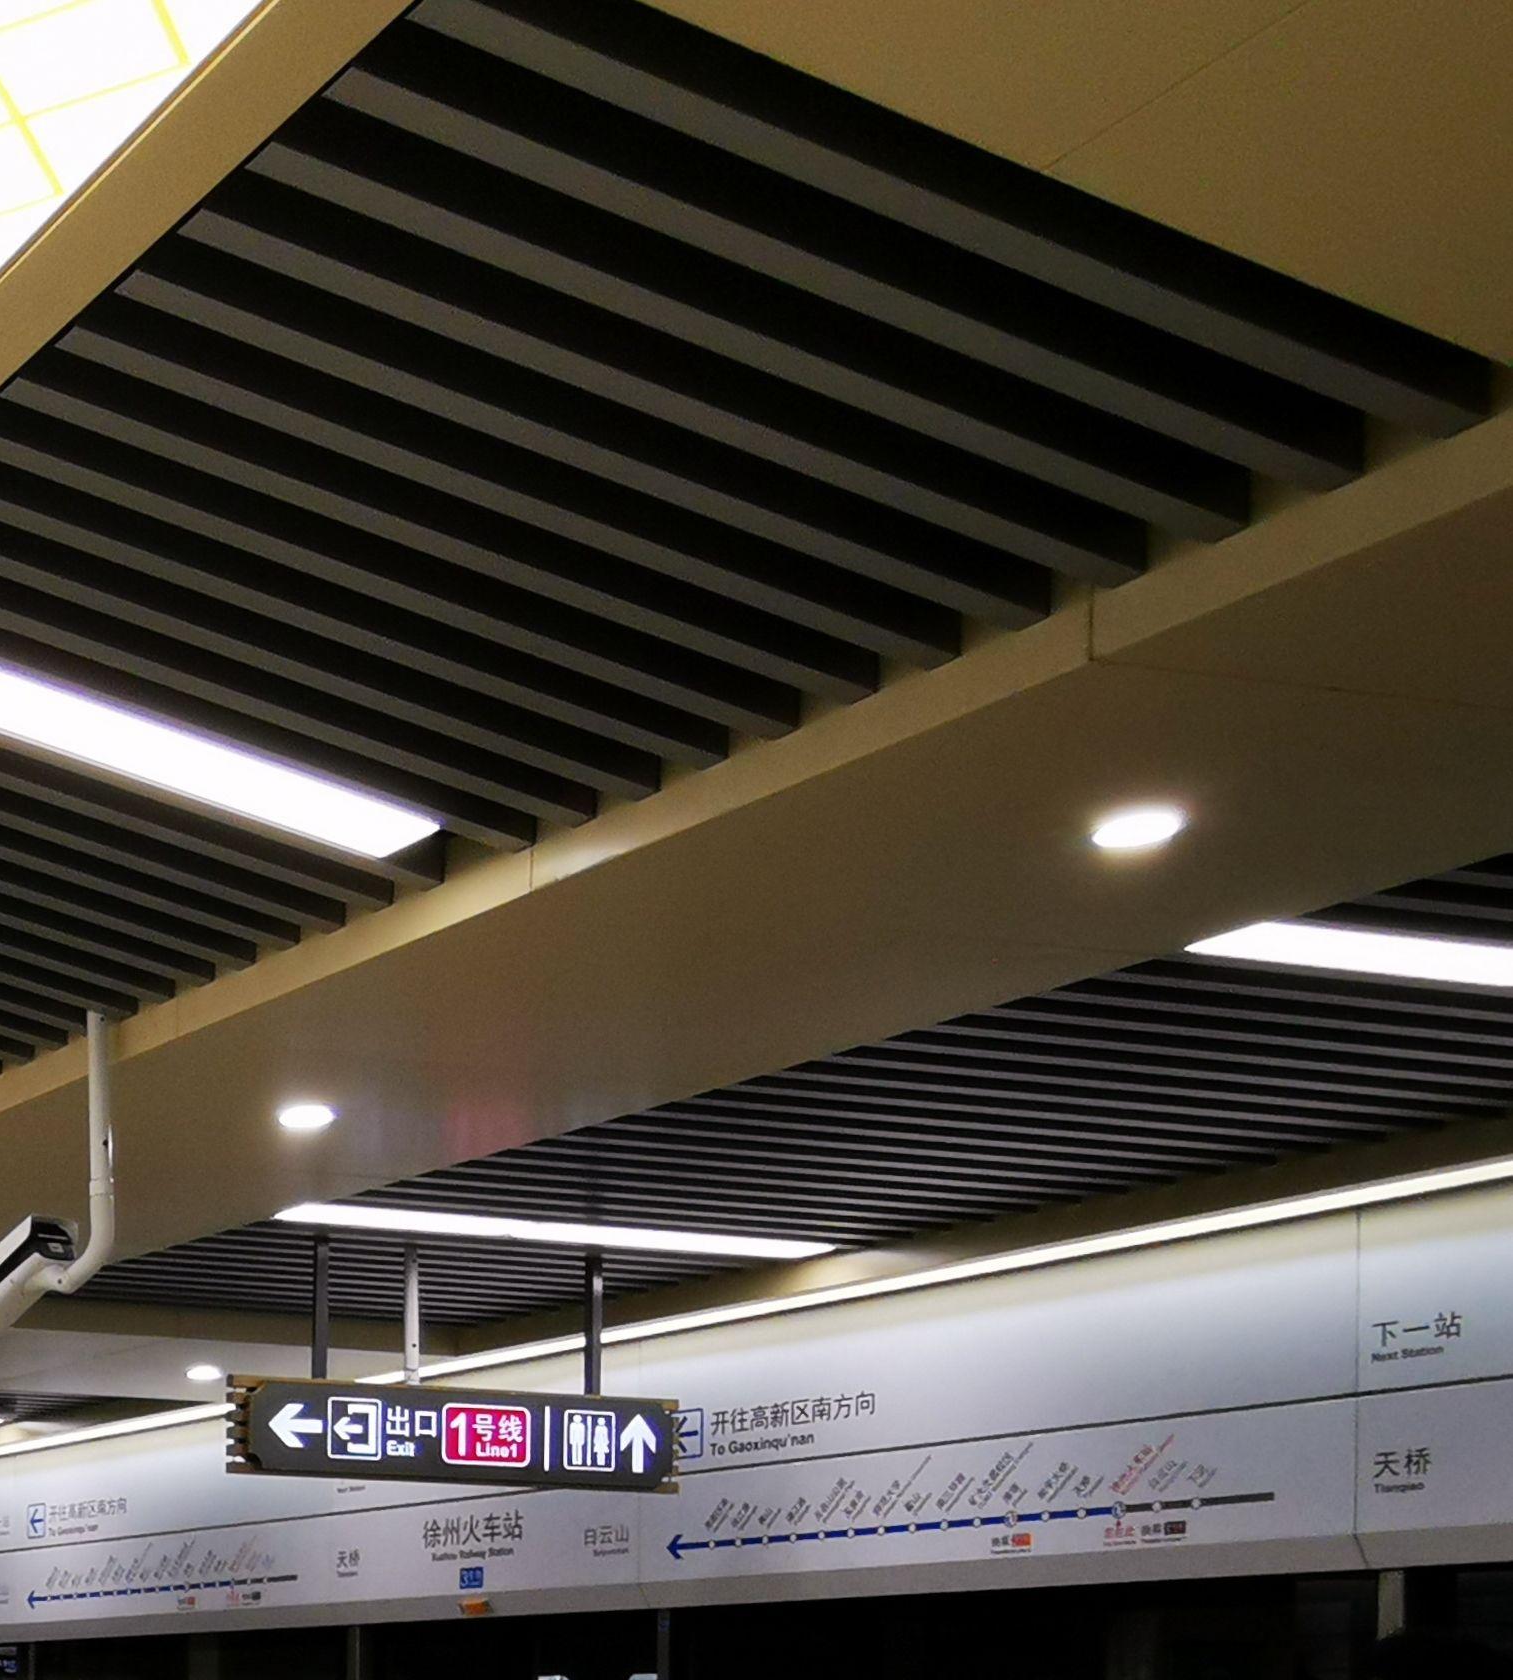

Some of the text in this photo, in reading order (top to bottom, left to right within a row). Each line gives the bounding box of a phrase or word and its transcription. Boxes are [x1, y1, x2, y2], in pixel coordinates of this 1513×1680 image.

[1371, 1311, 1463, 1347] 下一站
[1370, 1346, 1445, 1364] Next Station
[385, 1404, 438, 1438] 出口
[710, 1391, 876, 1436] 开往高新区南方向
[386, 1439, 416, 1458] Exit
[449, 1411, 524, 1457] 1号线
[475, 1440, 518, 1458] Line1
[710, 1433, 815, 1456] To Gaoxinqu'nan
[1373, 1447, 1434, 1478] 天桥
[422, 1509, 524, 1549] 徐州火车站
[583, 1524, 630, 1547] 白云山
